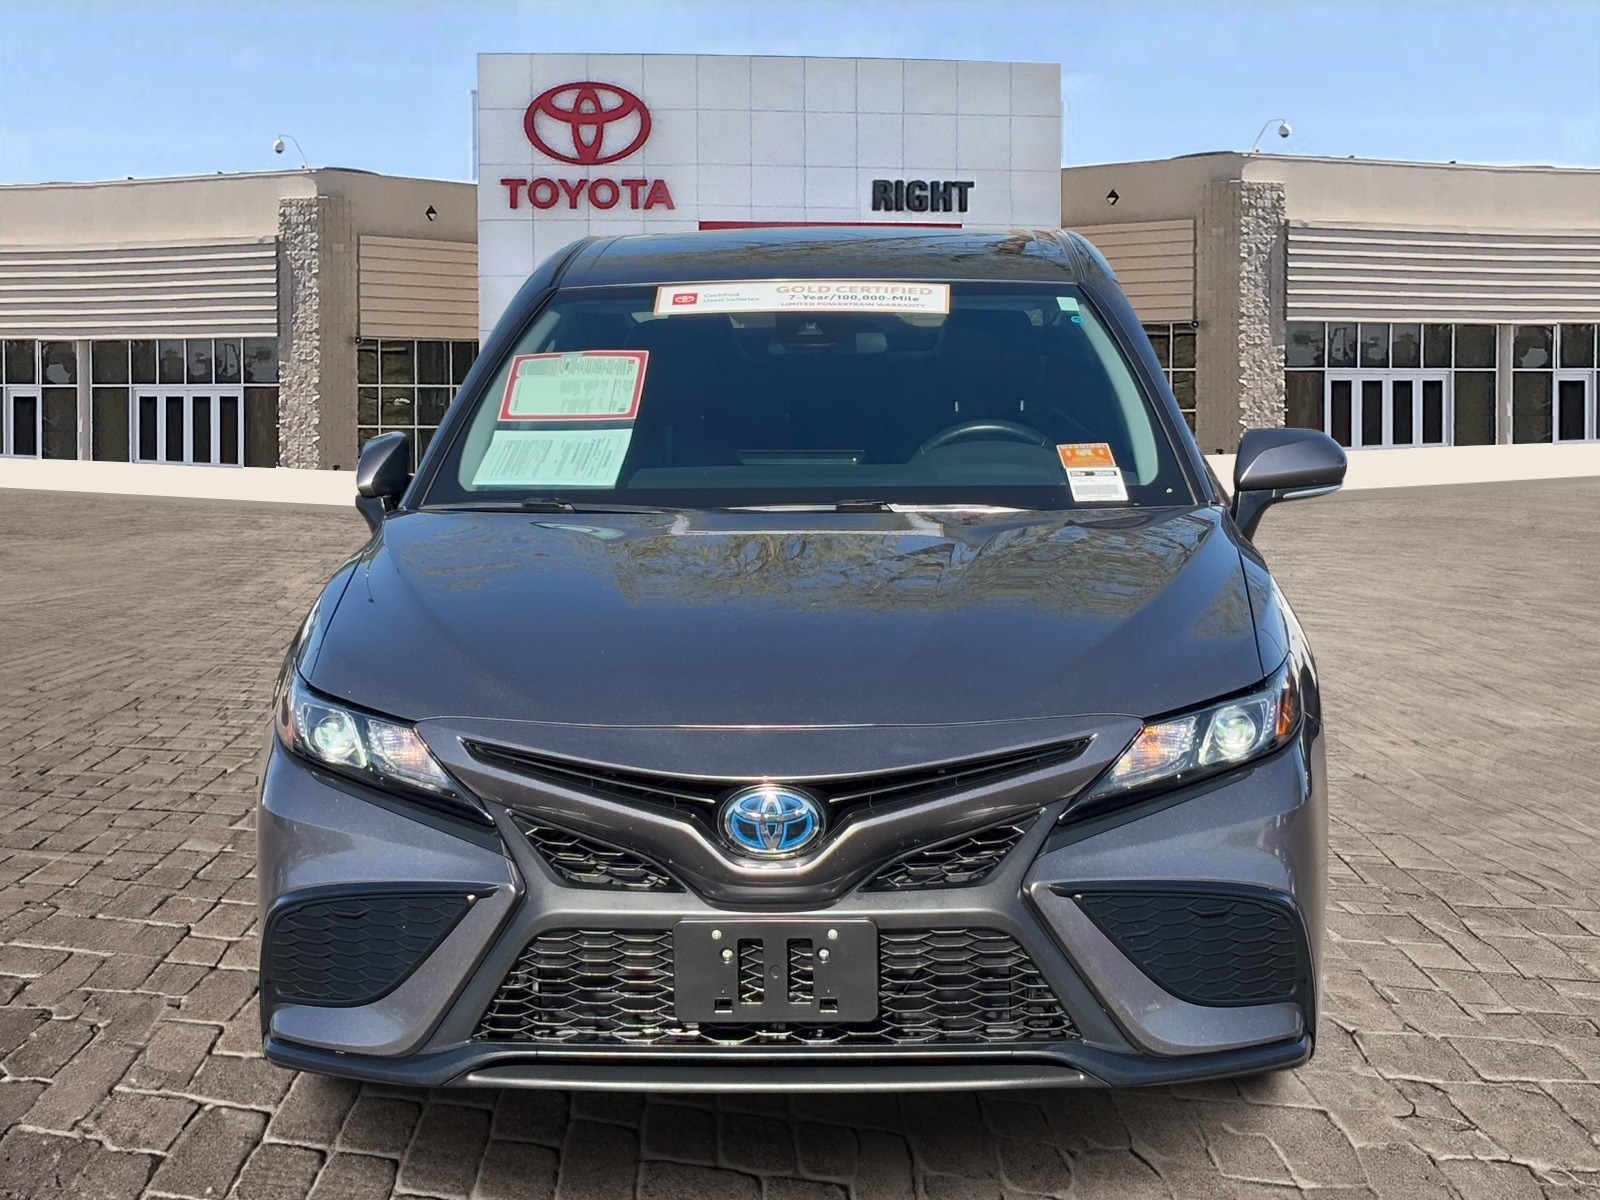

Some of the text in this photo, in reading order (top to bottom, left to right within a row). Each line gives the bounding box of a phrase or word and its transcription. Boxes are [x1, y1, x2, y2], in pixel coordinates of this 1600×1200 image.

[501, 178, 675, 210] TOYOTA
[871, 179, 975, 213] RIGHT
[776, 285, 933, 296] GOLD CERTIFIED
[788, 294, 920, 302] 7-Year/100,000-Mile
